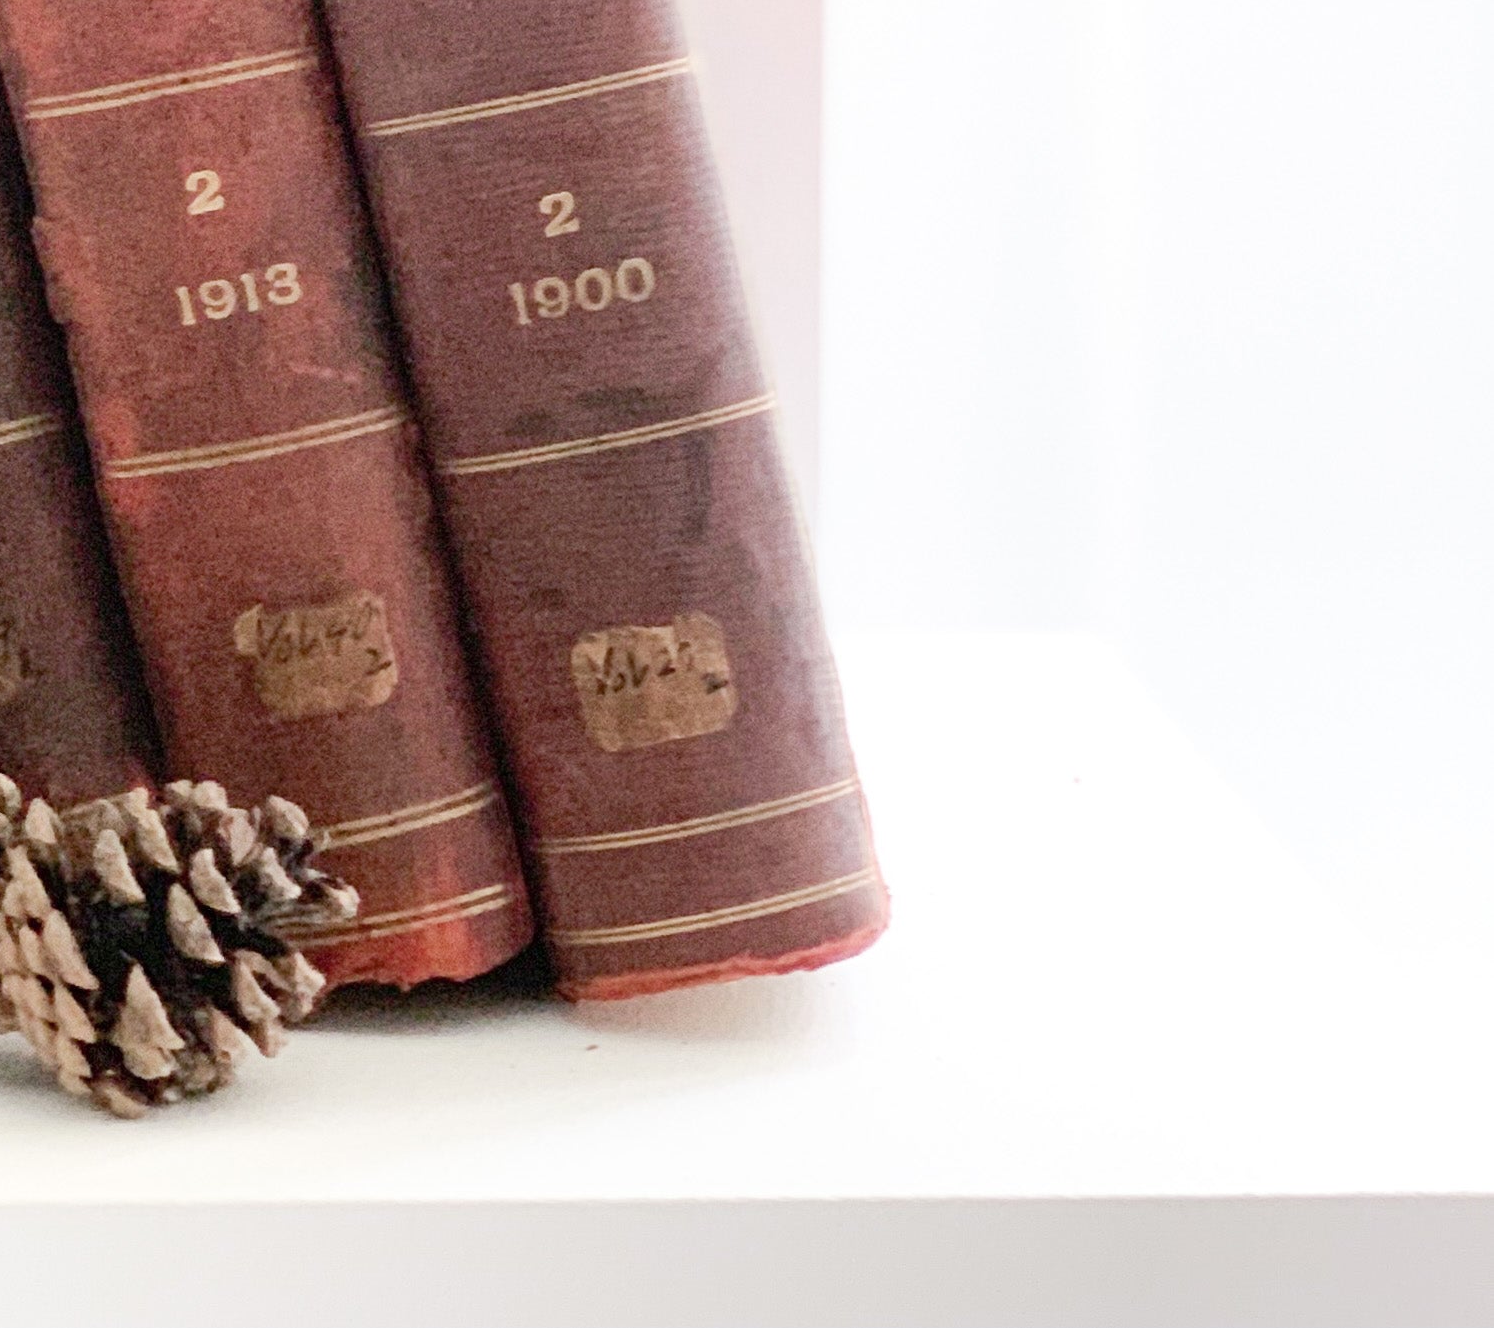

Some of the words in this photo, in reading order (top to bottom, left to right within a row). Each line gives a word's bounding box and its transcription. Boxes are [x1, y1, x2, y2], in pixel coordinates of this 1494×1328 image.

[184, 168, 226, 216] 2
[538, 190, 581, 239] 2
[174, 261, 304, 327] 1913
[506, 256, 656, 326] 1900
